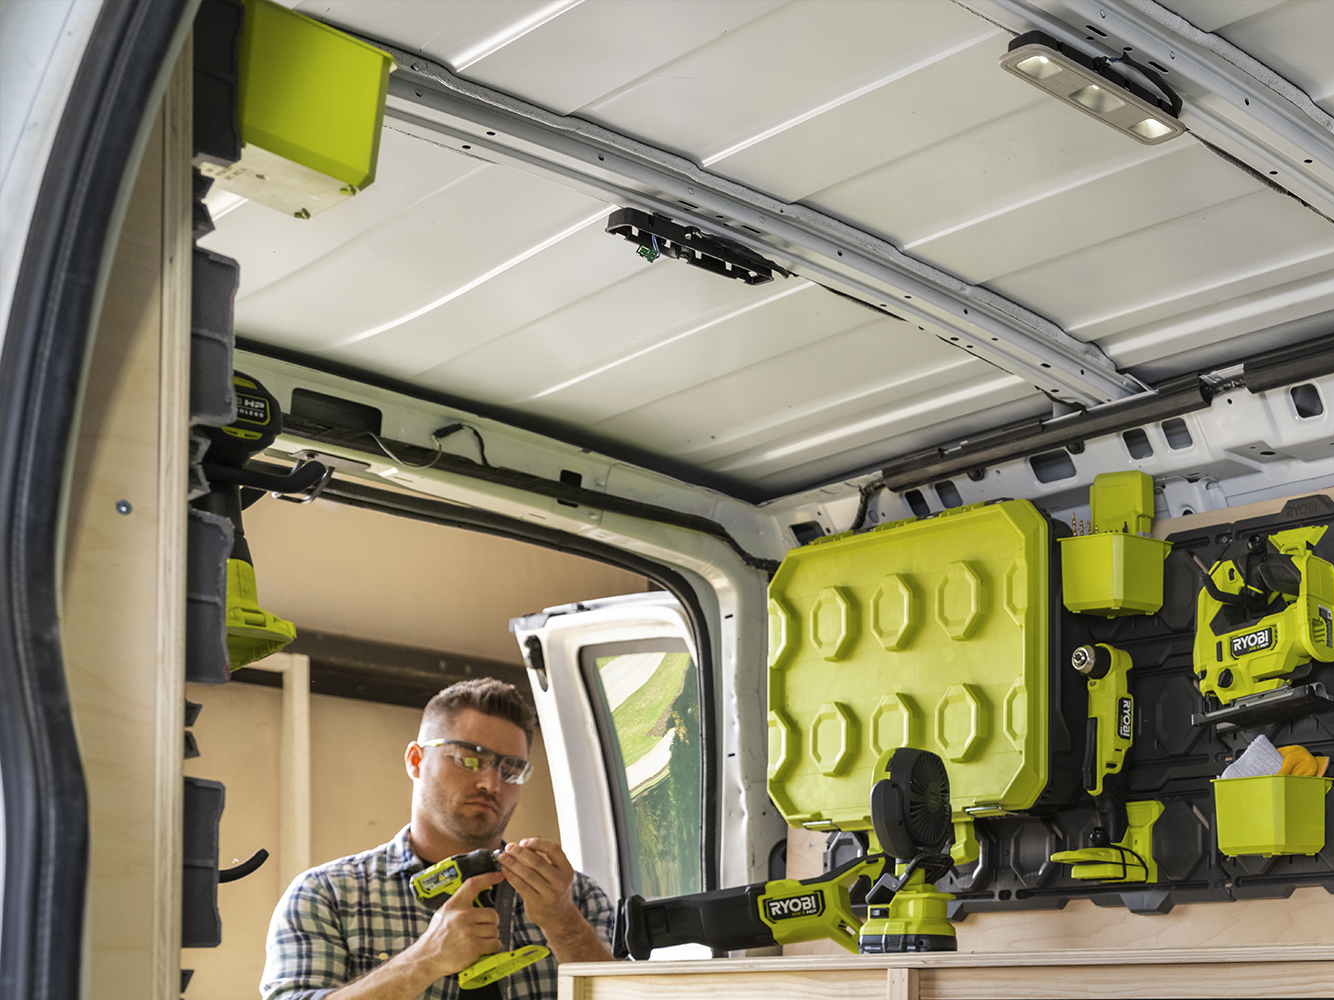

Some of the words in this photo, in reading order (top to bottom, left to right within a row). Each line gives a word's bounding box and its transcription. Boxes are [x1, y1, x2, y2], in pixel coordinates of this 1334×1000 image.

[1232, 630, 1269, 651] RYOBI
[1123, 700, 1132, 737] RYOBI
[769, 896, 817, 916] RYOBI
